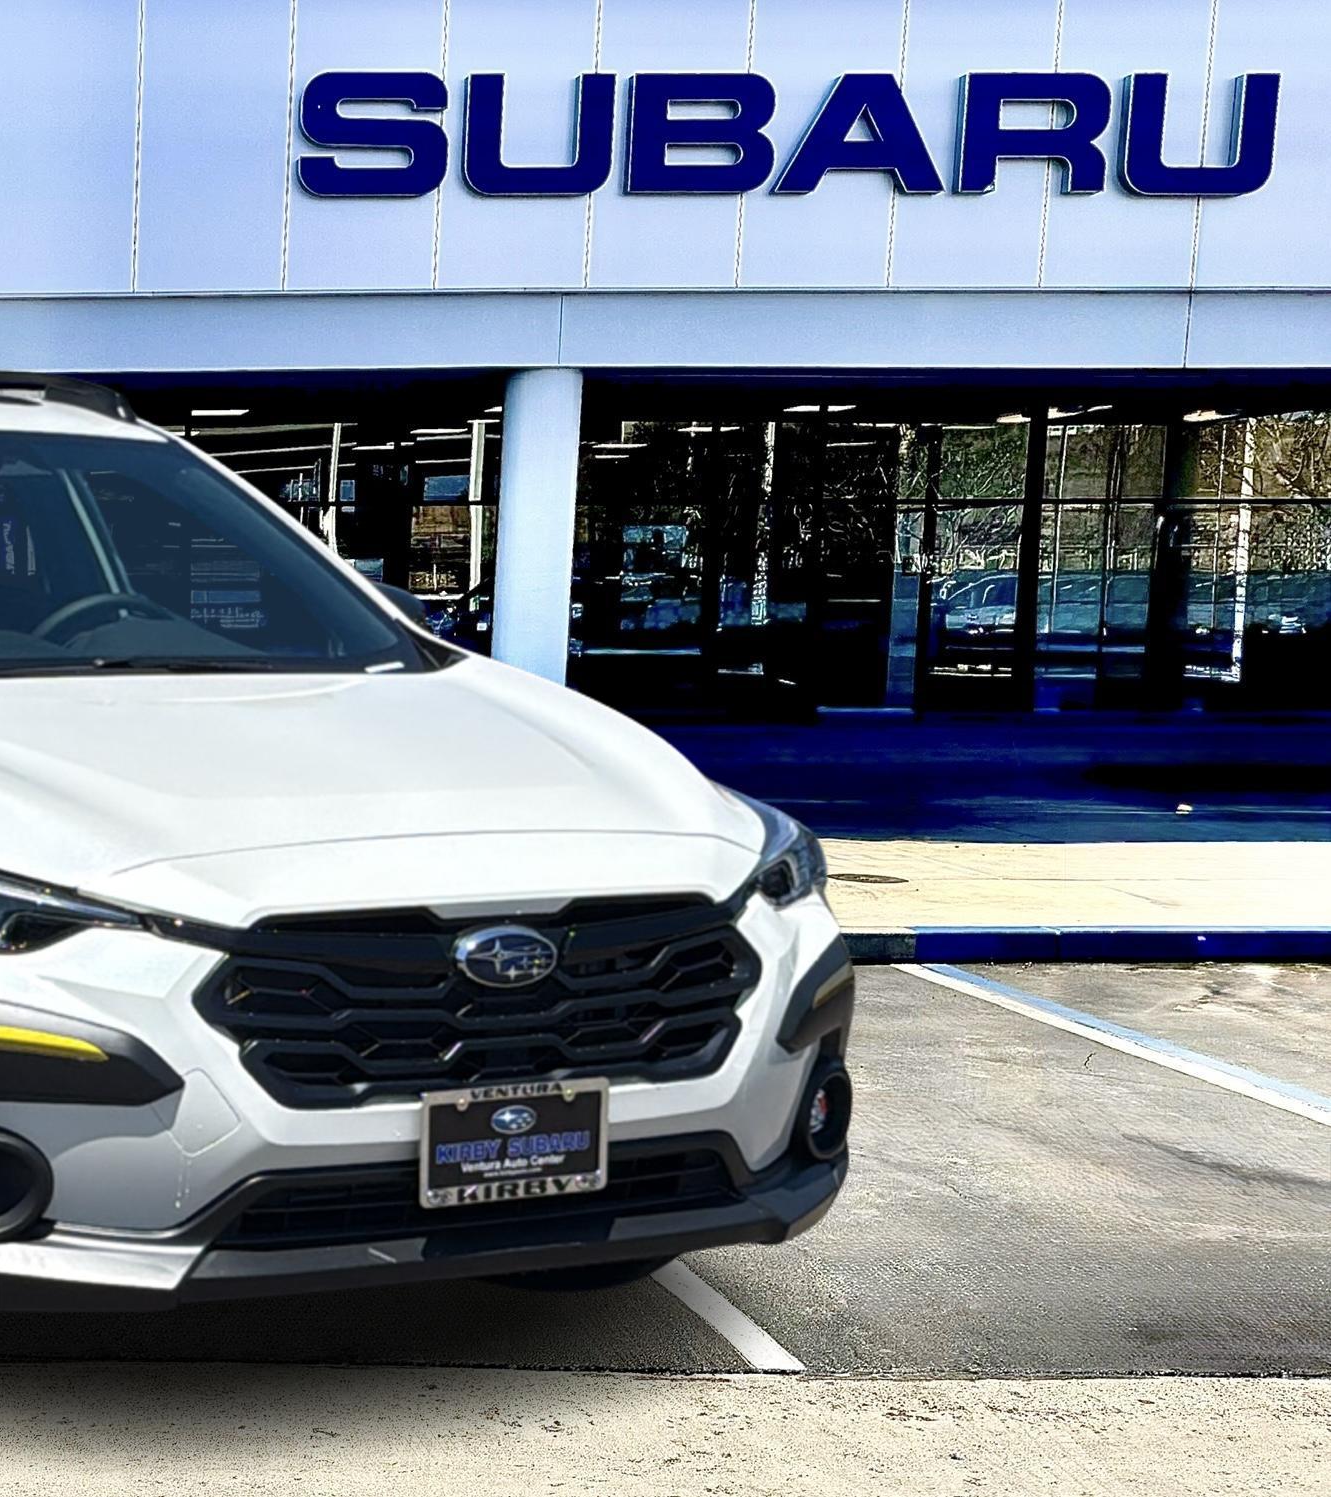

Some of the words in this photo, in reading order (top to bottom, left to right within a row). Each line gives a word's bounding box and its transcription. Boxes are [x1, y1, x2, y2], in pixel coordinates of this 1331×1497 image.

[296, 70, 1282, 198] SUBARU
[471, 1082, 562, 1099] VENTURA
[436, 1139, 501, 1164] KIRBY
[507, 1131, 589, 1158] SUBARU
[461, 1159, 501, 1174] Ventura
[503, 1156, 528, 1170] Auto
[530, 1153, 566, 1167] Center
[458, 1178, 571, 1202] KIRBY
